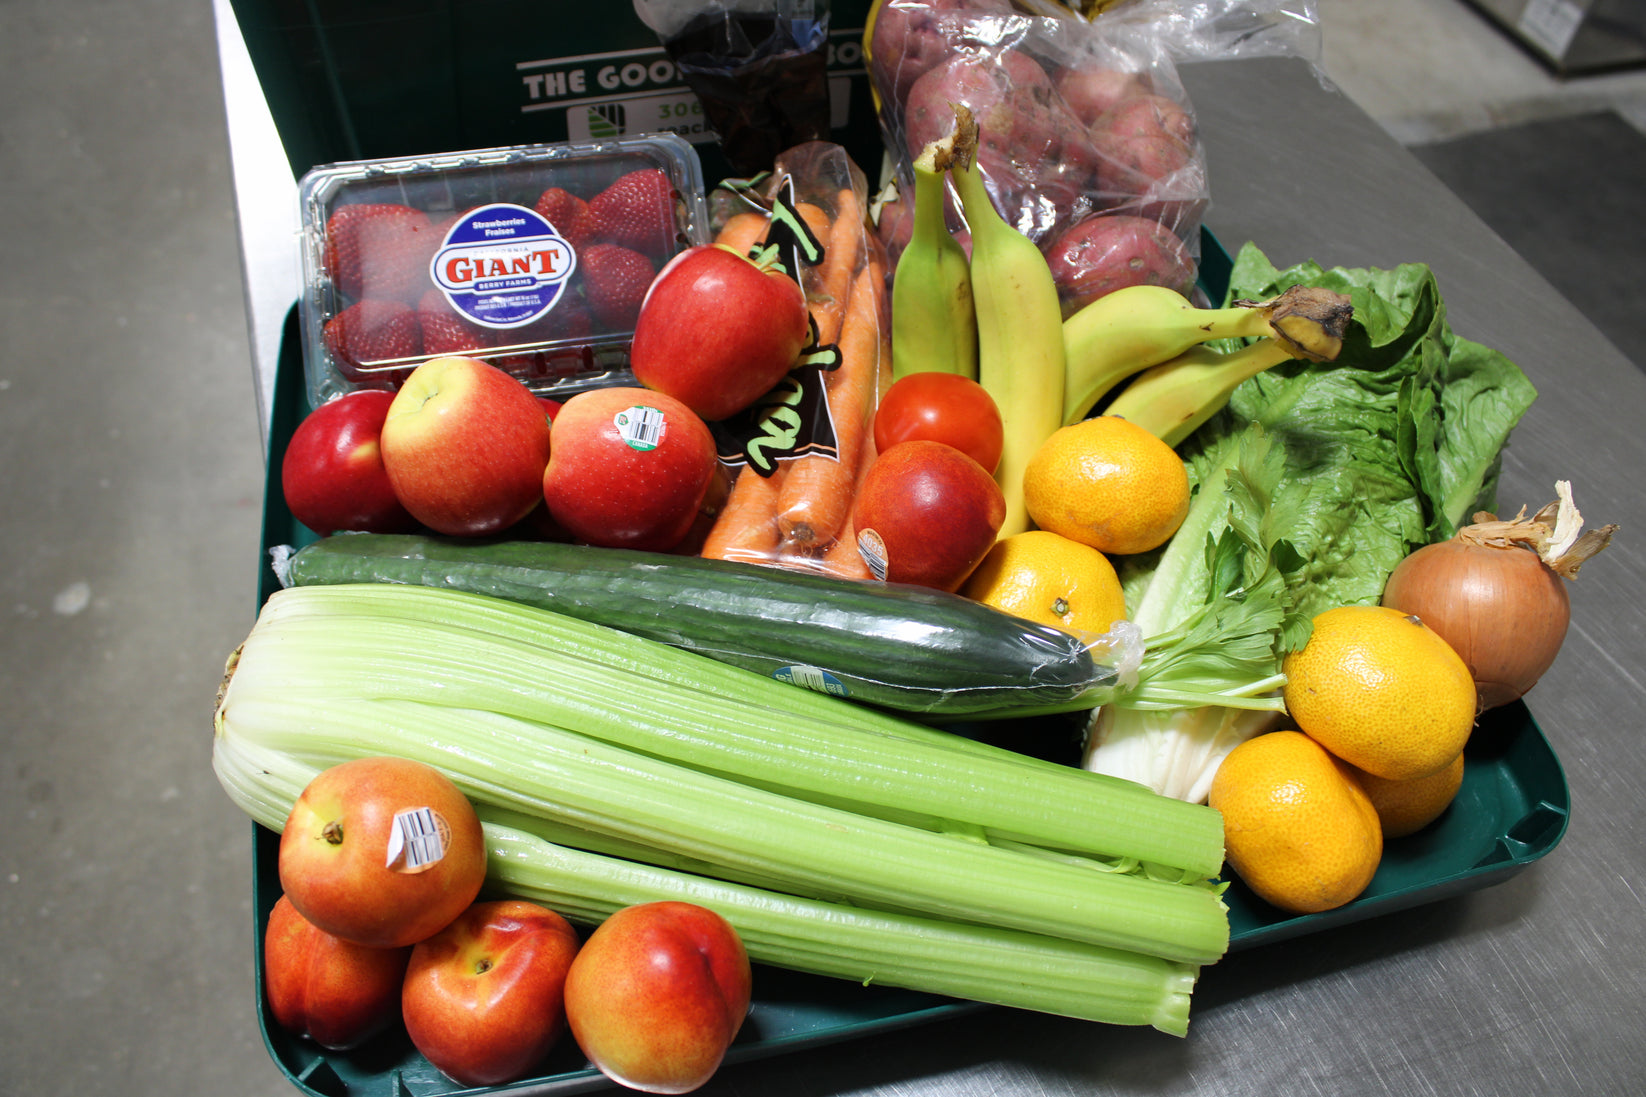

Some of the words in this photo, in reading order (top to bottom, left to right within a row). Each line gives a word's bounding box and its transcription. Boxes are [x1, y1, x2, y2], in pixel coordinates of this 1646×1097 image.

[522, 69, 586, 100] THE
[597, 58, 684, 91] GOO
[472, 218, 526, 229] Strawberries
[485, 227, 516, 237] Fraises
[446, 249, 560, 284] GIANT
[478, 280, 504, 290] BERRY
[505, 278, 532, 288] FARMS
